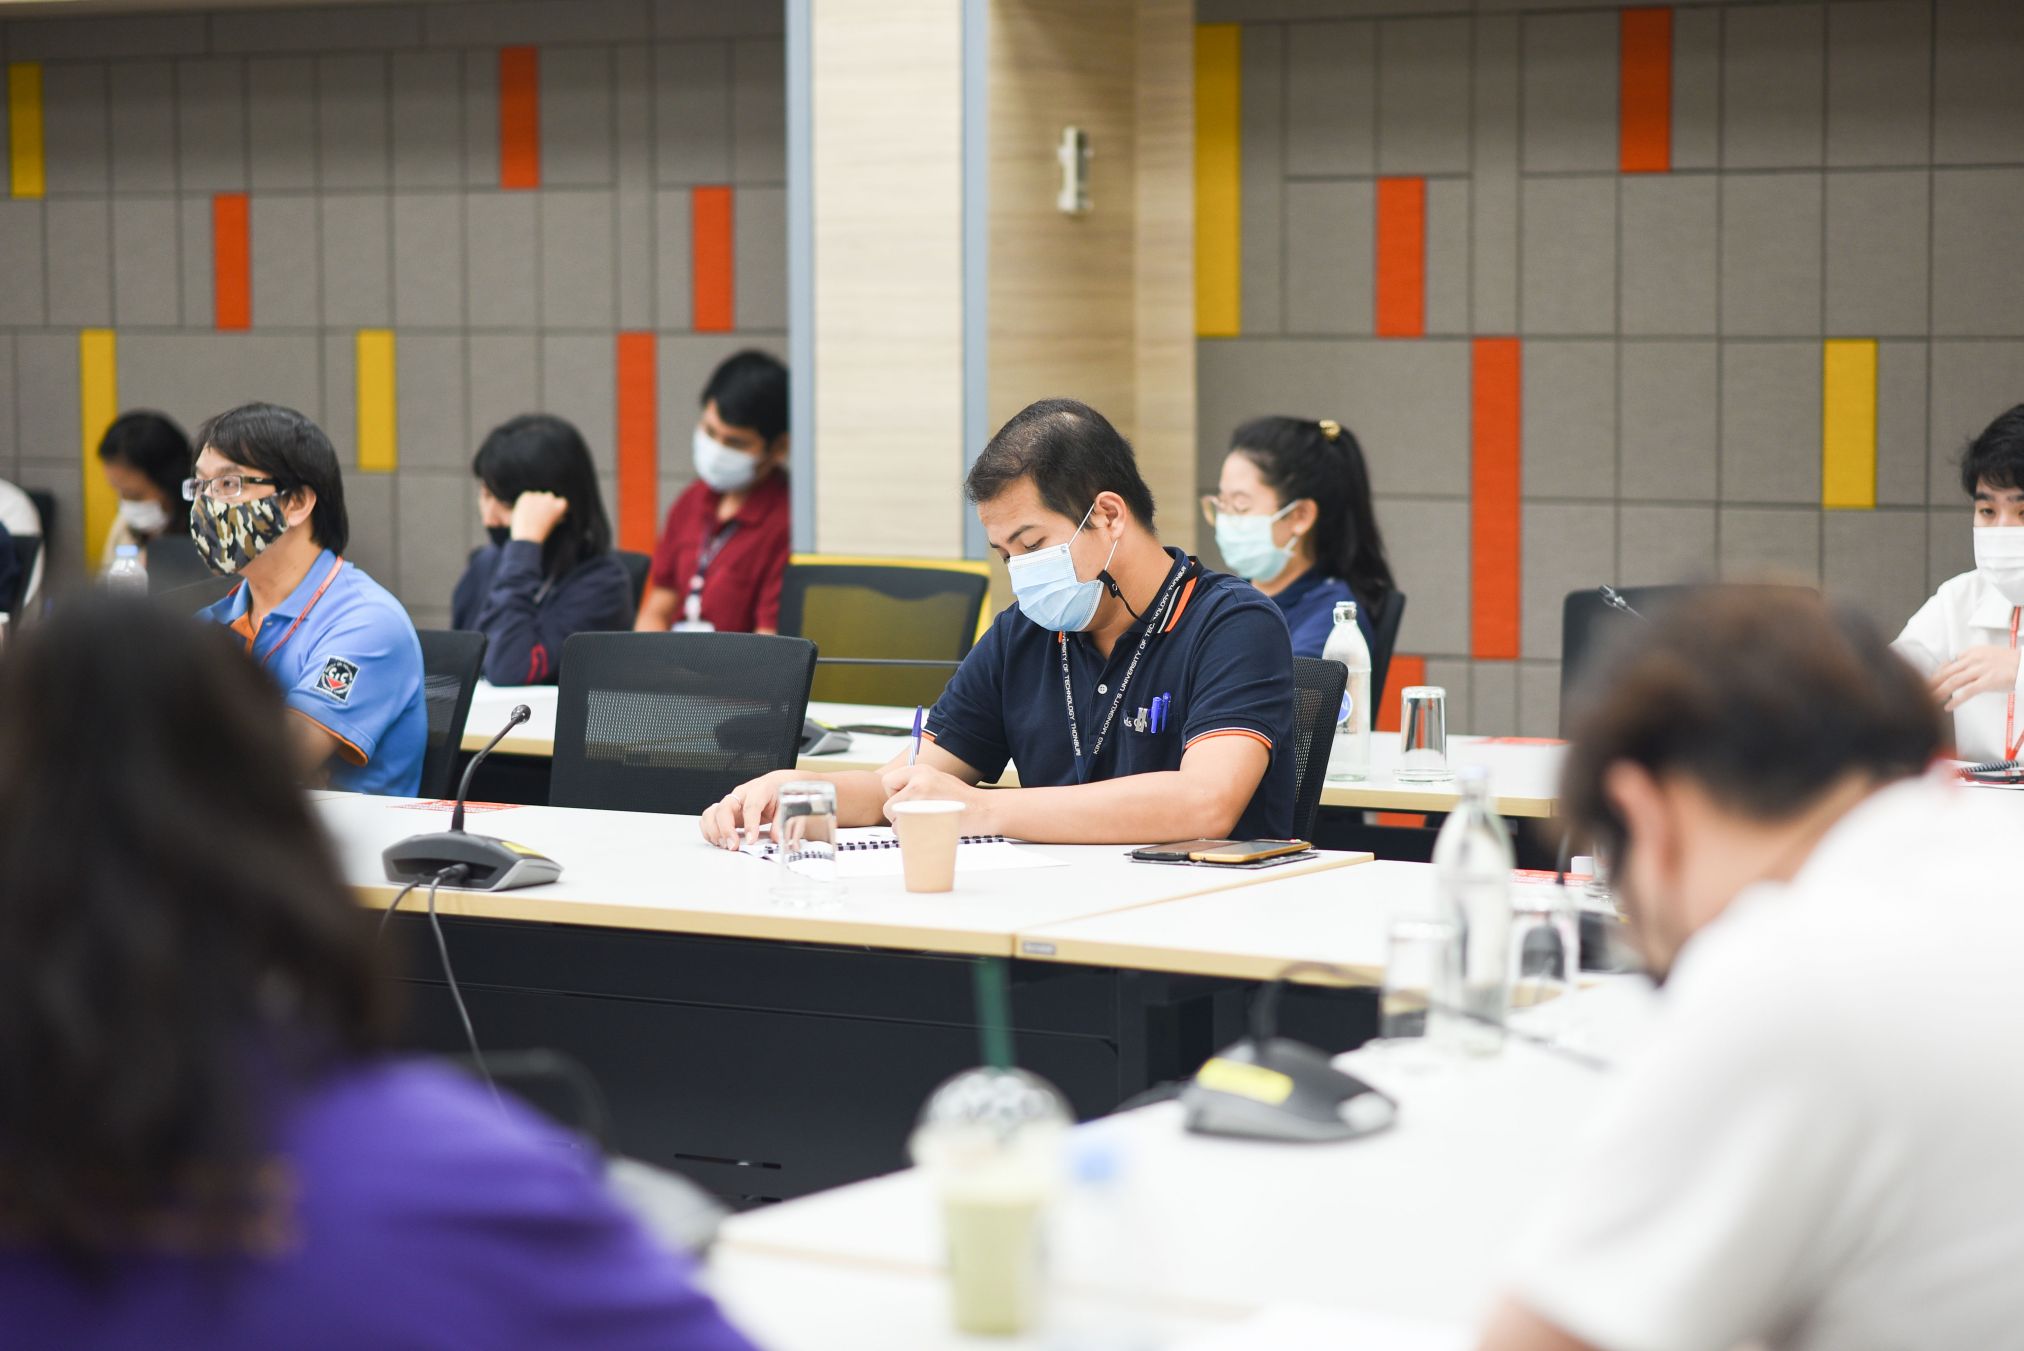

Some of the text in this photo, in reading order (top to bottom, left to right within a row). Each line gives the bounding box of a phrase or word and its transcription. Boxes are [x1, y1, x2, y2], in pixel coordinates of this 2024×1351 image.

[1062, 663, 1069, 673] OF
[1064, 674, 1076, 721] TECHNOLOGY
[1093, 736, 1104, 754] KING
[1119, 650, 1142, 692] UNIVERSITY
[1139, 639, 1147, 650] OF
